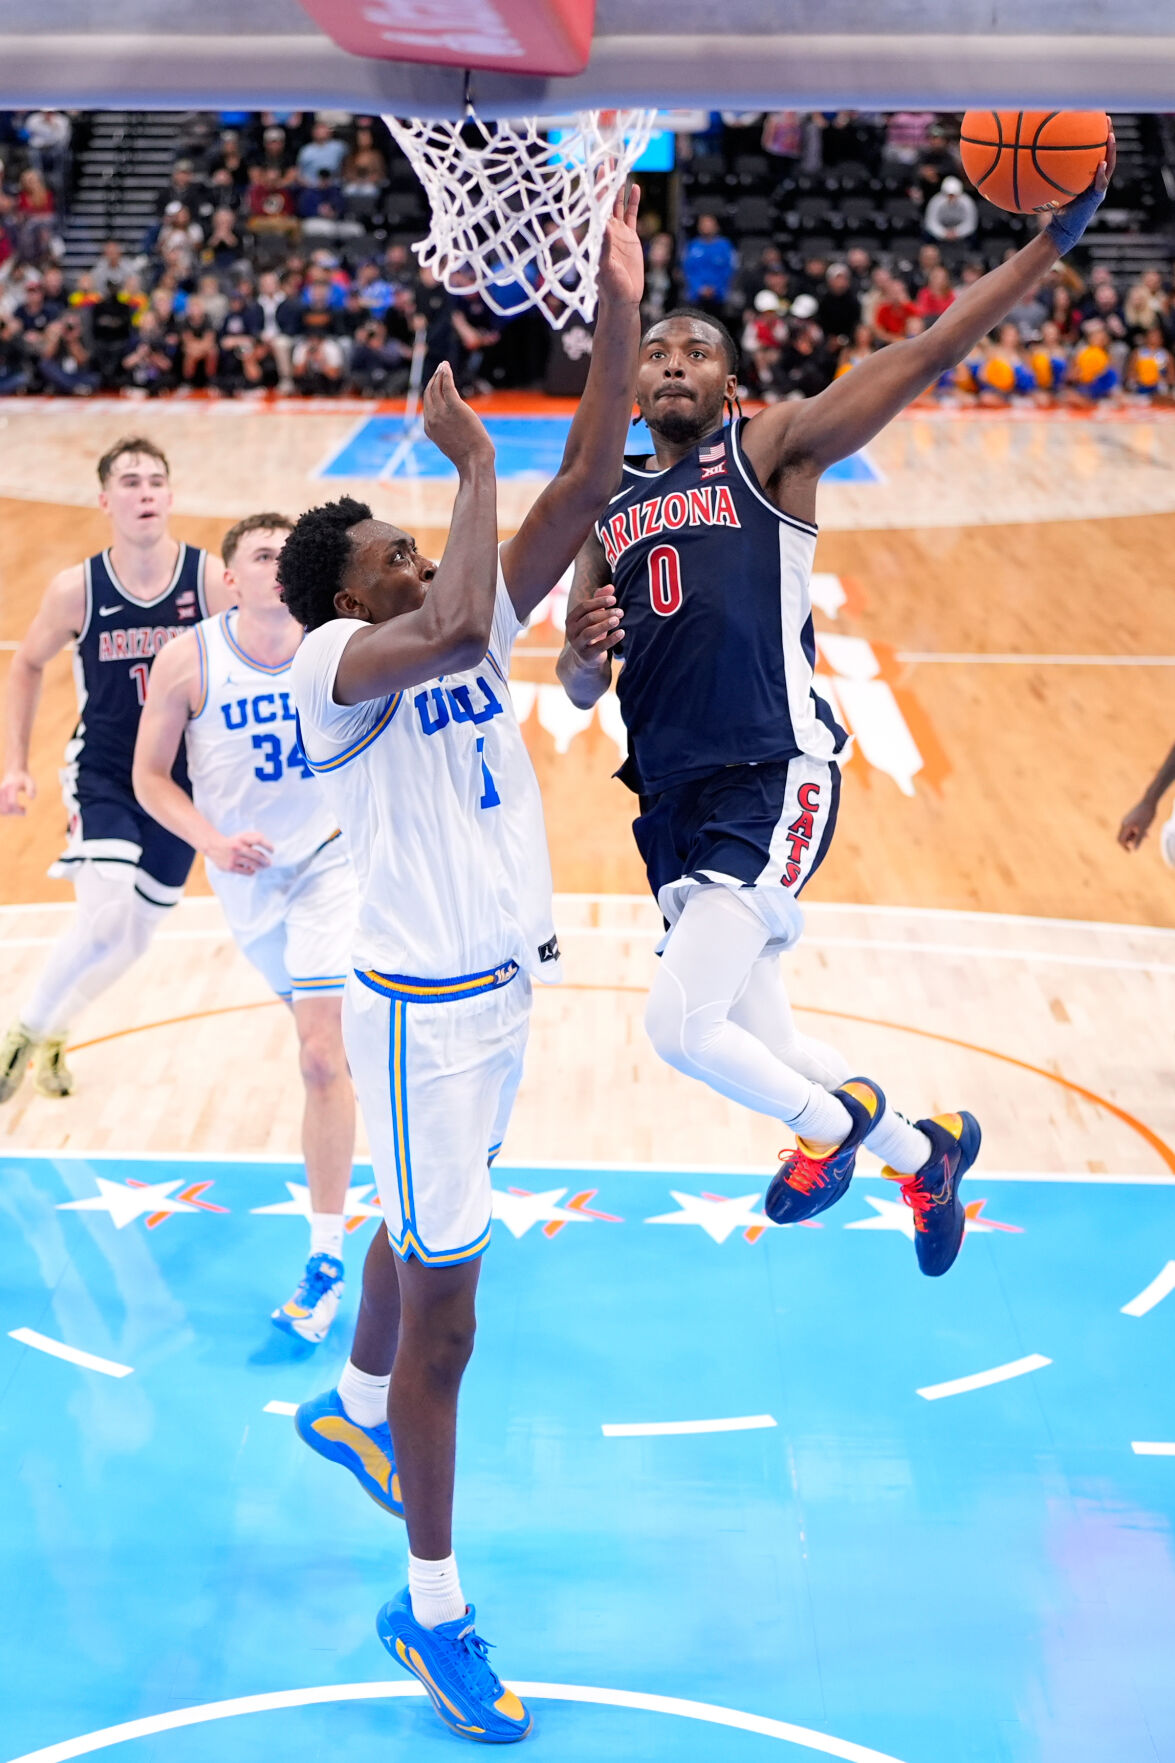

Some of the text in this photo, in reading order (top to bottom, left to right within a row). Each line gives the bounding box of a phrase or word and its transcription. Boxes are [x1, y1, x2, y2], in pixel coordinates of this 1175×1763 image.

[600, 486, 741, 573] ARIZONA
[647, 544, 683, 617] 0
[99, 626, 193, 661] ARIZO
[221, 692, 296, 731] UCL
[780, 782, 820, 888] CATS
